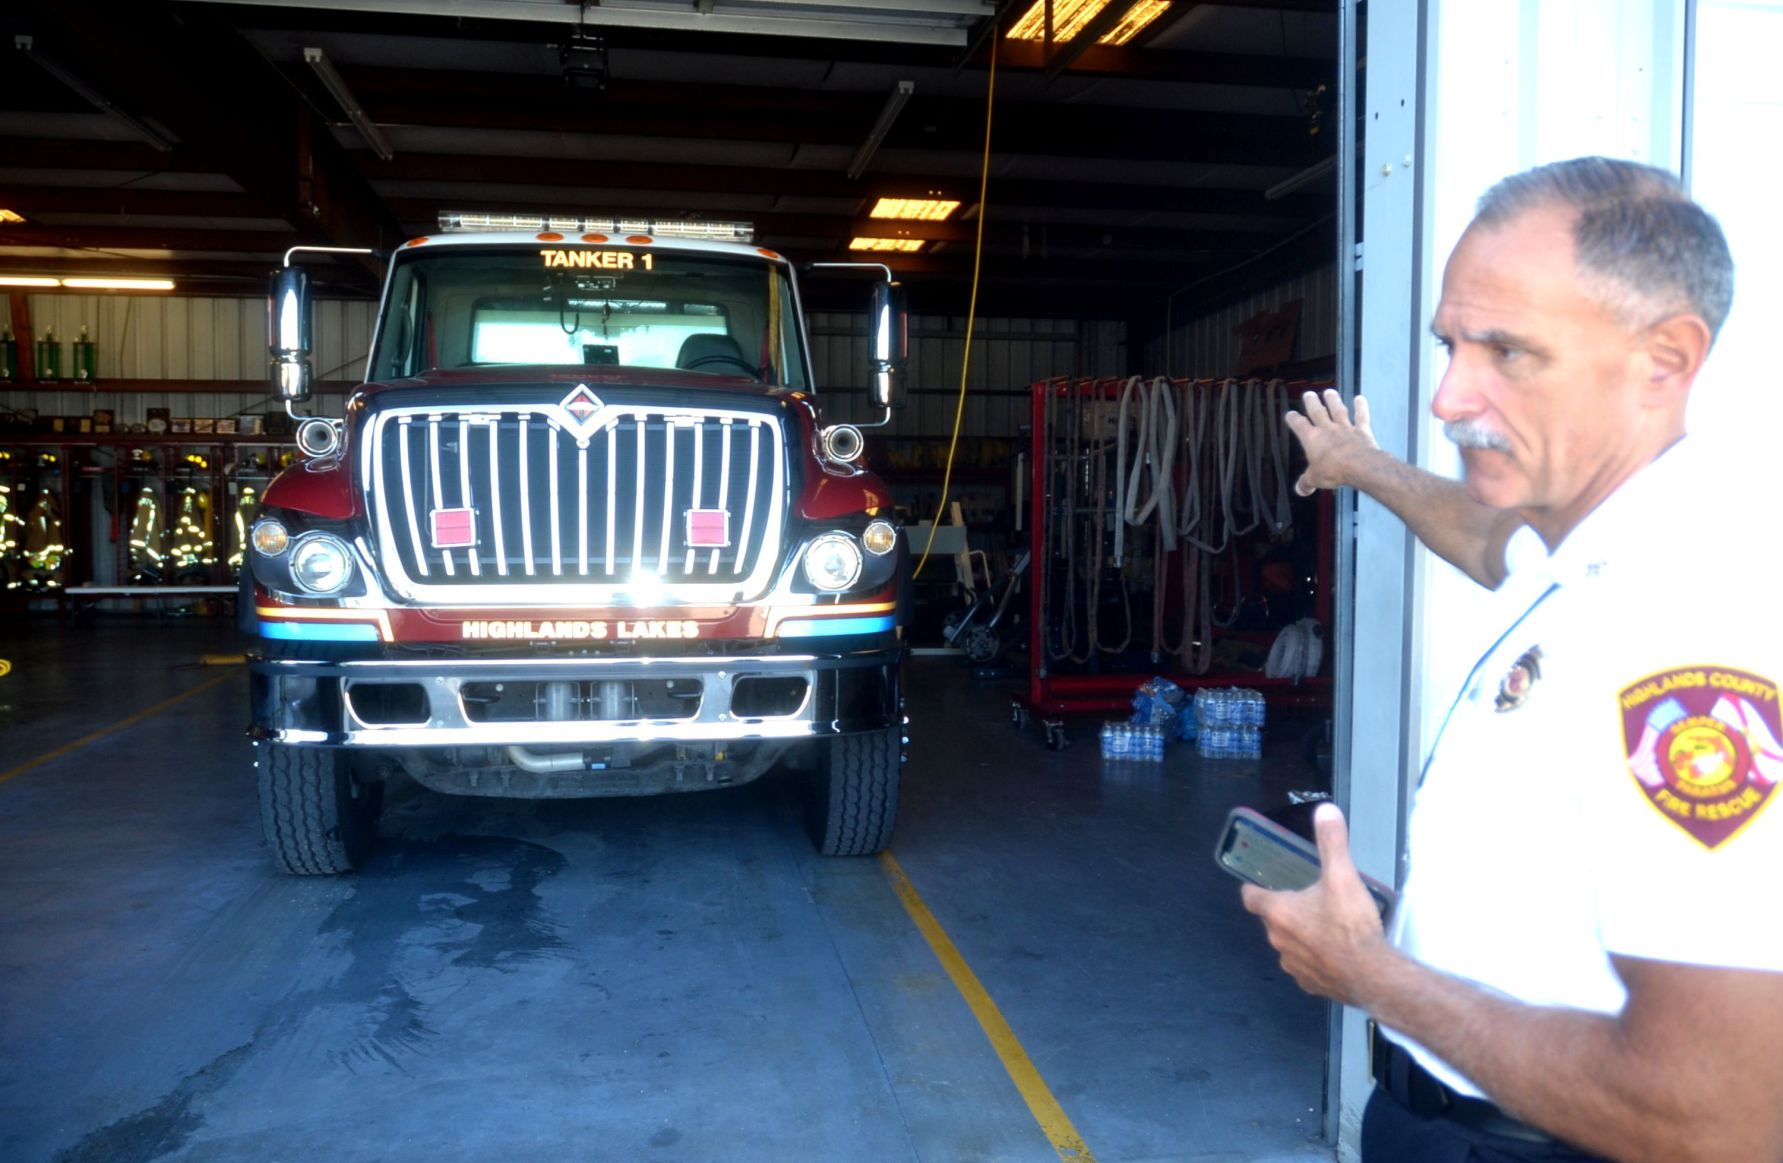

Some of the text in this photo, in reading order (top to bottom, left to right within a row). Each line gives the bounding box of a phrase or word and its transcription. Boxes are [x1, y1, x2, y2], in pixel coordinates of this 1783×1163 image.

[540, 250, 653, 270] TANKER 1
[462, 620, 699, 638] HIGHLANDS LAKES
[1622, 671, 1776, 709] HIGHLANDS COUNTY
[1655, 788, 1692, 816] FIRE
[1695, 786, 1763, 820] RESCUE
